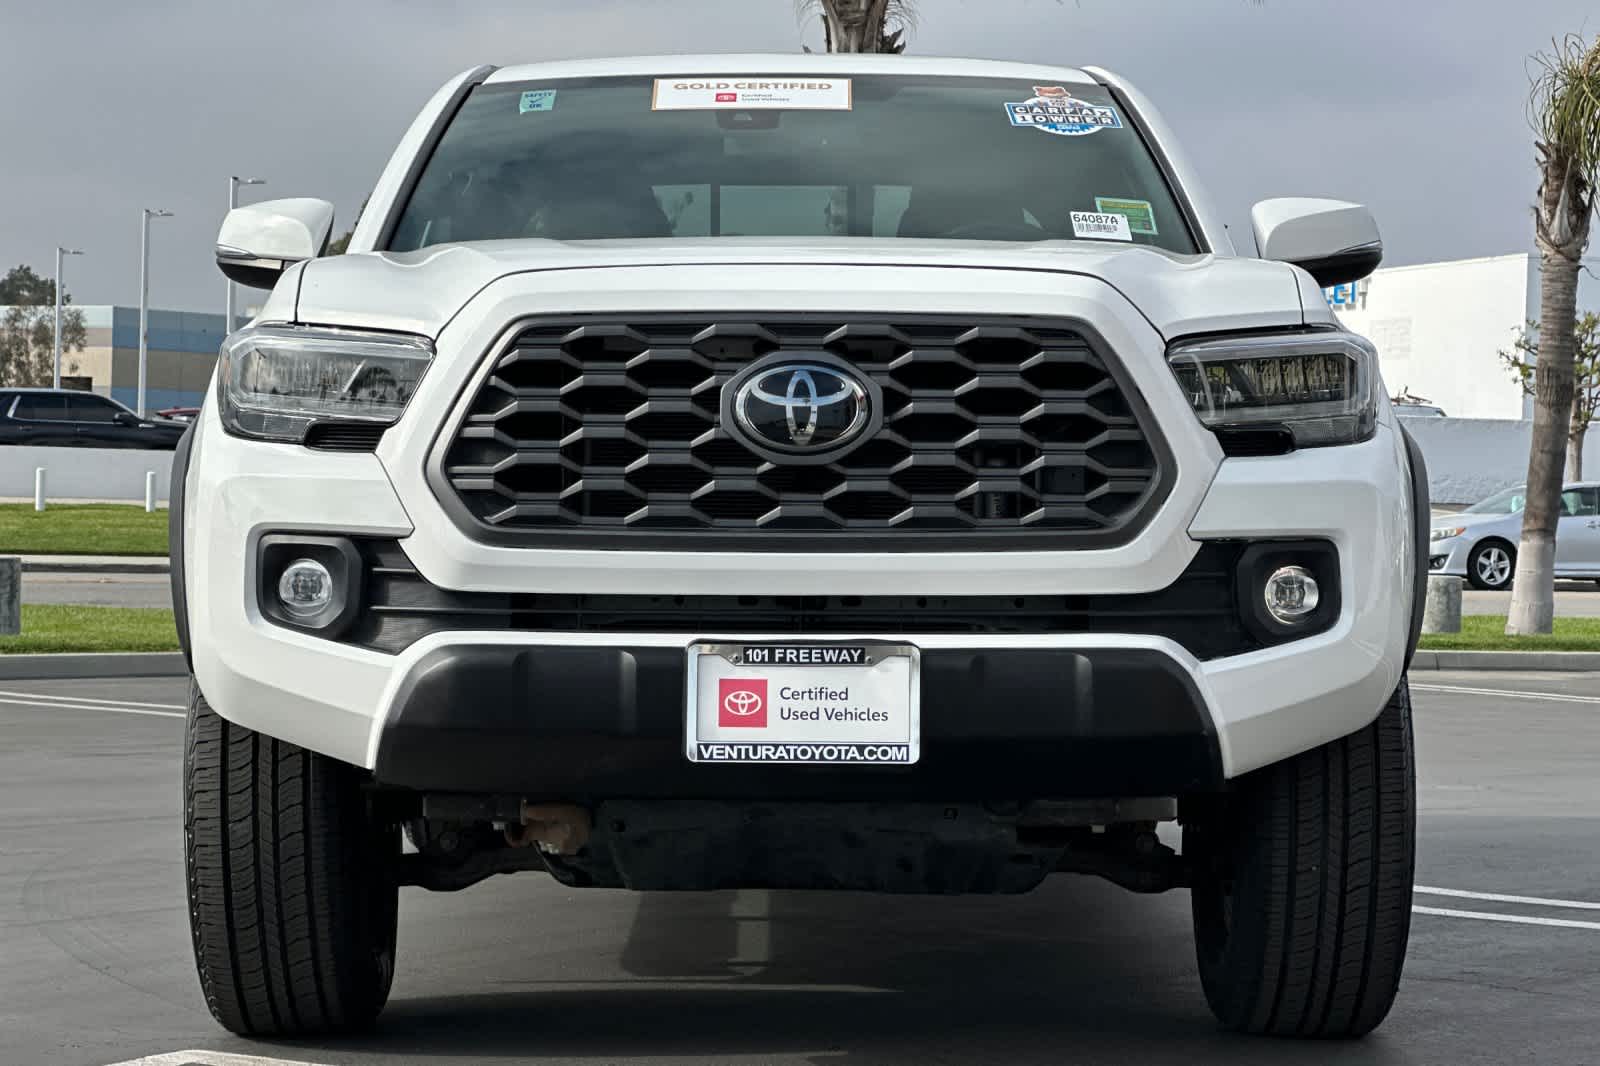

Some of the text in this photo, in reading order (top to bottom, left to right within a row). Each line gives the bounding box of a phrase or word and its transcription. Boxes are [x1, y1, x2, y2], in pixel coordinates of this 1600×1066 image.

[673, 82, 833, 90] GOLD CERTIFIED
[1015, 106, 1112, 116] CARFAX
[1035, 116, 1113, 125] OWNER
[1072, 213, 1119, 225] 64087A
[745, 649, 863, 663] 101 FREEWAY
[780, 686, 849, 701] Certified
[780, 707, 889, 722] Used Vehicles
[700, 744, 908, 761] VENTURATOYOTA.COM
